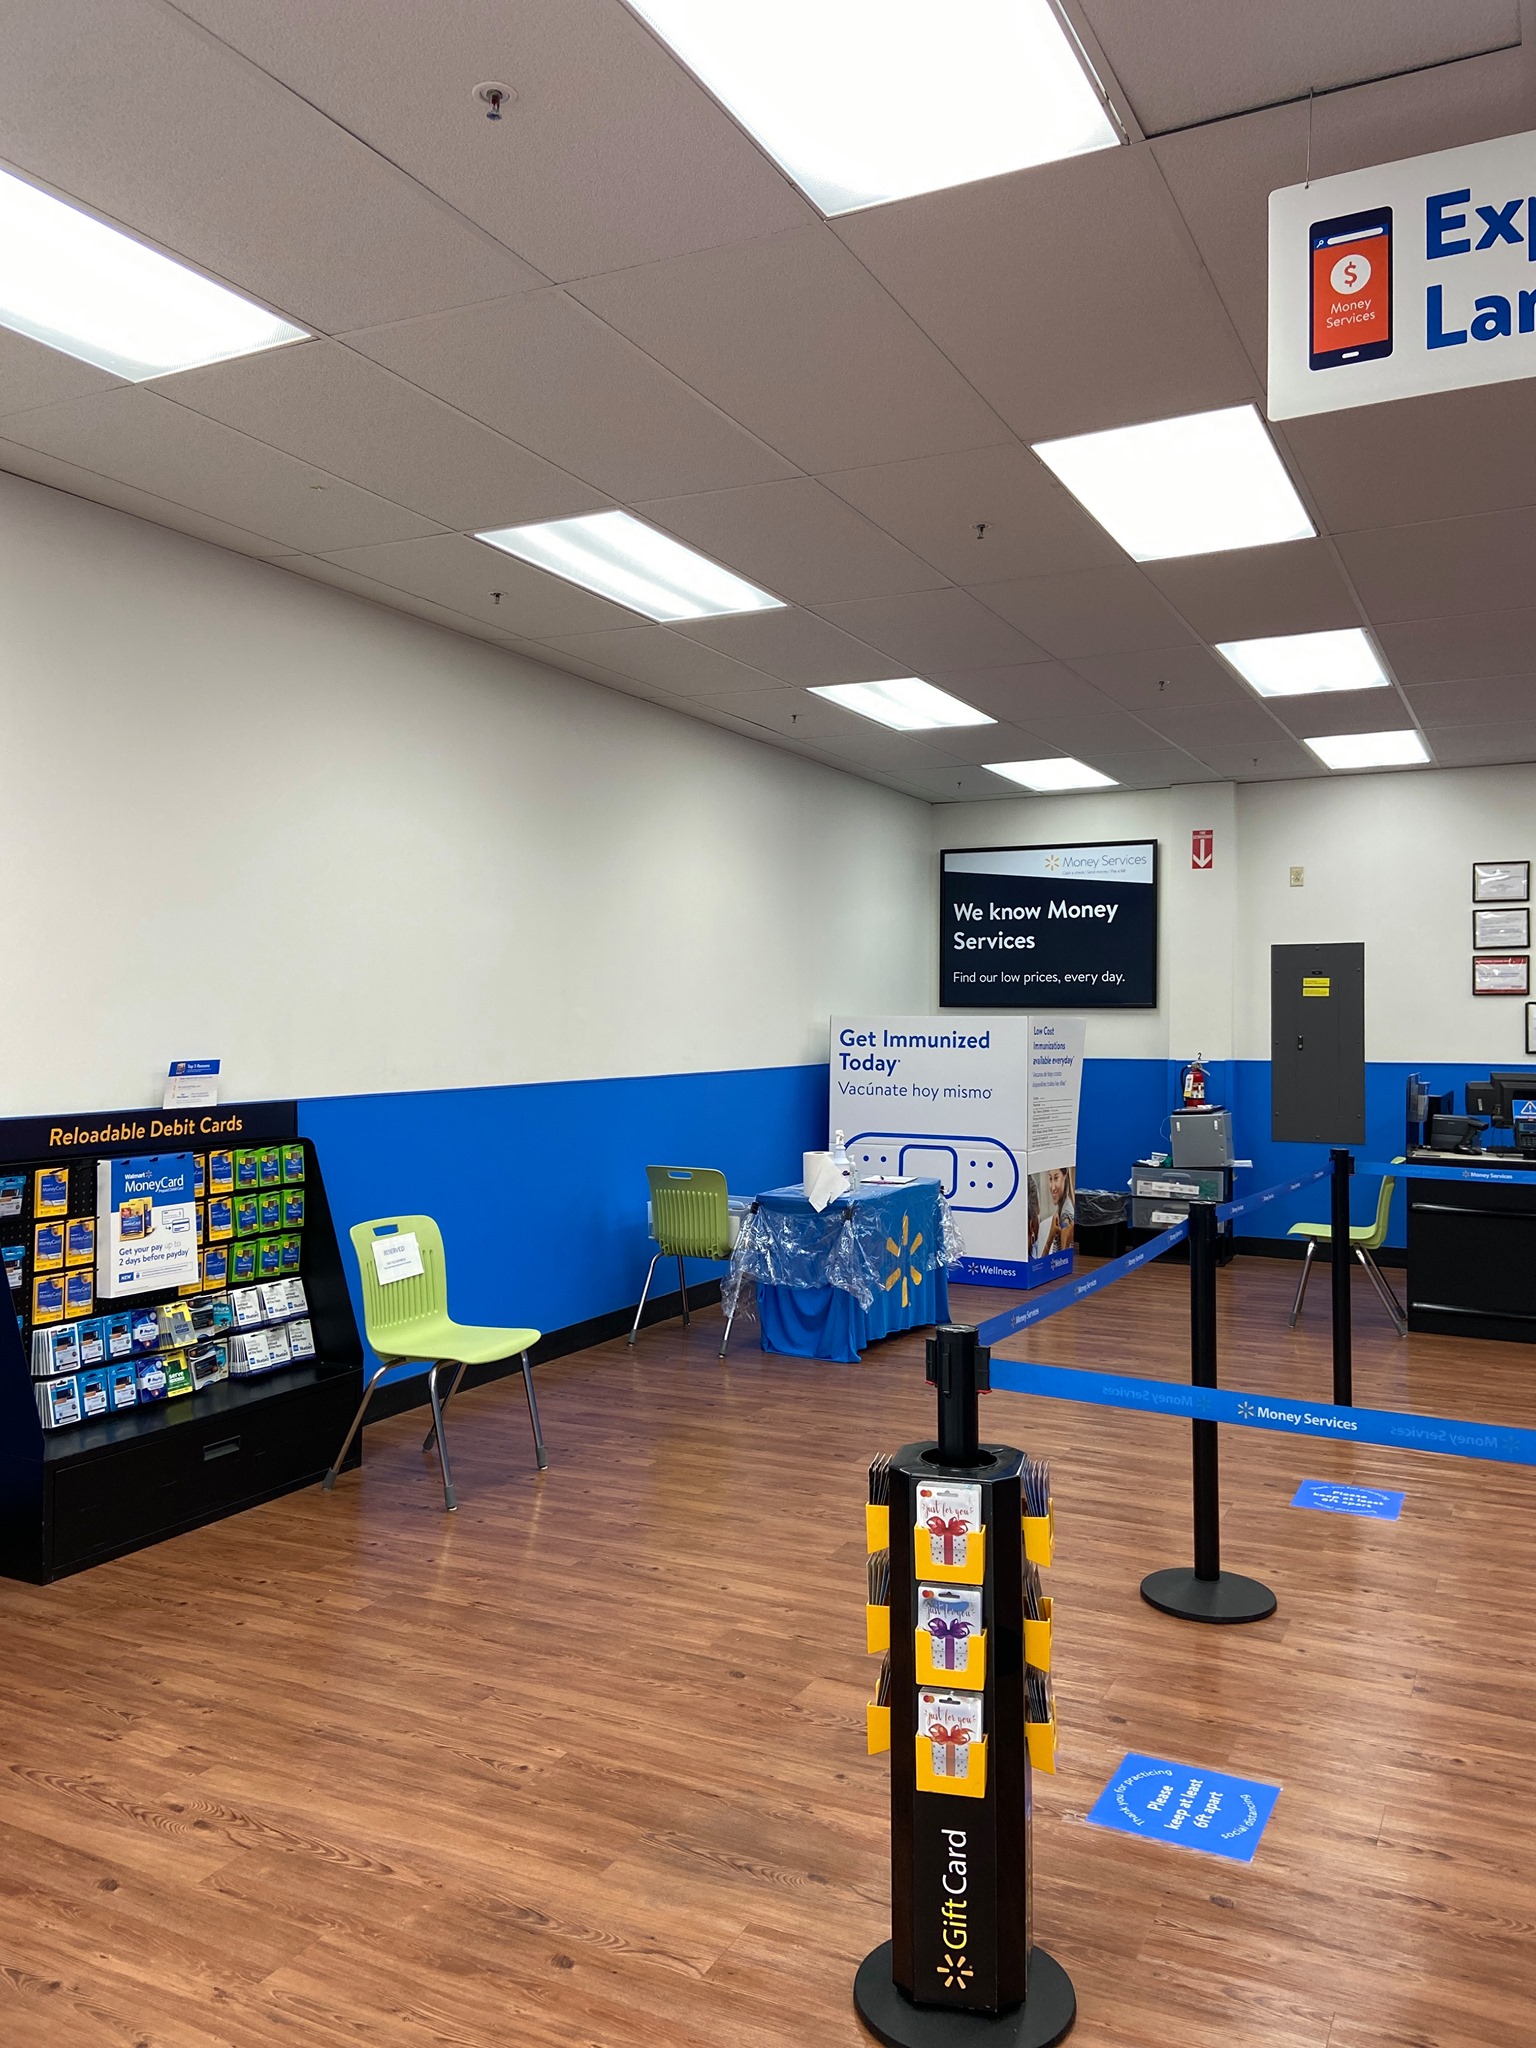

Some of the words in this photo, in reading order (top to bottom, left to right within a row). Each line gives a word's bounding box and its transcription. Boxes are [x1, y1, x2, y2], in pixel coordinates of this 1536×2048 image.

[1426, 188, 1536, 262] Ex
[1330, 299, 1372, 314] Money
[1326, 310, 1376, 329] Services
[1063, 856, 1099, 869] Money
[1101, 854, 1147, 866] Services
[954, 903, 983, 921] We
[990, 902, 1041, 921] know
[1048, 900, 1118, 923] Money
[954, 931, 1035, 950] Services
[953, 972, 976, 983] Find
[979, 974, 998, 983] our
[1001, 971, 1020, 982] low
[1023, 972, 1061, 985] prices,
[1064, 972, 1098, 985] every
[1101, 970, 1125, 985] day.
[839, 1029, 877, 1047] Get
[883, 1030, 990, 1049] Immunized
[1033, 1026, 1042, 1036] Low
[1044, 1026, 1055, 1036] Cost
[1033, 1041, 1066, 1050] Immunizations
[1032, 1056, 1051, 1065] available
[838, 1080, 908, 1097] Vacúnate
[913, 1083, 938, 1101] hoy
[49, 1123, 145, 1147] Reloadable
[150, 1118, 196, 1138] Debit
[200, 1115, 243, 1134] Cards
[125, 1172, 146, 1180] Walmart
[125, 1174, 184, 1193] MoneyCard
[119, 1248, 133, 1256] Get
[134, 1247, 149, 1256] your
[151, 1244, 163, 1252] pay
[125, 1256, 141, 1266] days
[142, 1253, 165, 1262] before
[980, 1264, 1016, 1276] Wellness
[1257, 1406, 1301, 1425] Money
[1304, 1413, 1358, 1431] Services
[925, 1500, 939, 1518] just
[942, 1502, 952, 1517] for
[955, 1508, 969, 1520] you
[927, 1706, 941, 1725] just
[944, 1710, 955, 1724] for
[958, 1716, 972, 1728] you
[1124, 1769, 1172, 1786] practicing
[1114, 1784, 1127, 1793] for
[1180, 1778, 1204, 1799] least
[1116, 1794, 1128, 1806] you
[1146, 1785, 1174, 1812] Please
[1179, 1798, 1194, 1809] at
[1119, 1806, 1145, 1826] Thank
[1164, 1809, 1192, 1830] keep
[1193, 1813, 1212, 1829] 6ft
[1204, 1792, 1224, 1814] apart
[1220, 1824, 1249, 1840] social
[1240, 1794, 1258, 1827] distancing
[941, 1829, 967, 1895] Card
[941, 1898, 967, 1950] Gift
